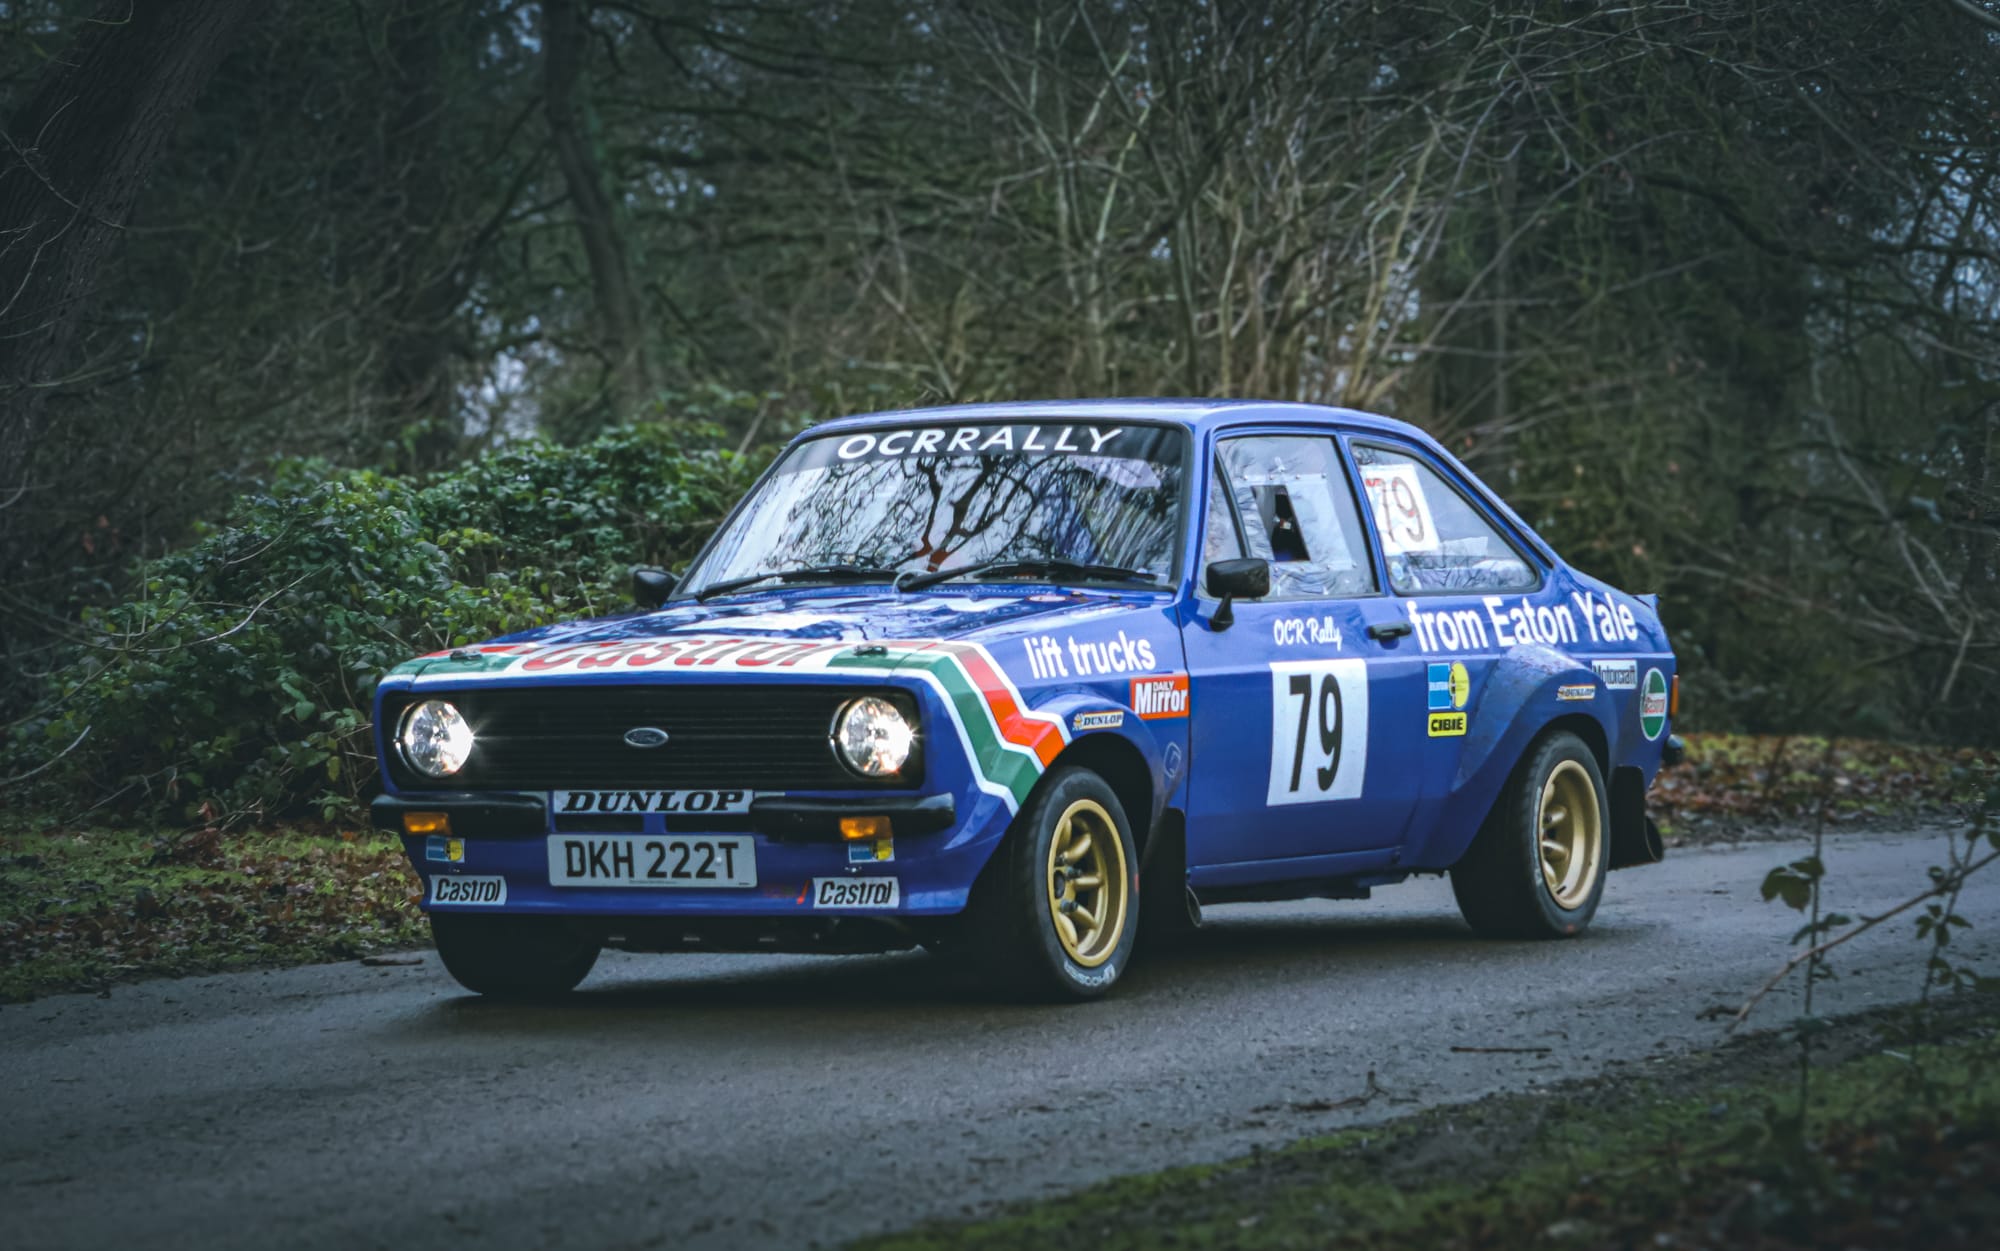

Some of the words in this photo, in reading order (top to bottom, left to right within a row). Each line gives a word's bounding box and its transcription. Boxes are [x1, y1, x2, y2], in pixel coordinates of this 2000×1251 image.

[1364, 476, 1425, 542] 79
[1273, 618, 1308, 647] OCR
[1306, 615, 1343, 652] Rally
[1406, 600, 1489, 653] from
[1482, 597, 1578, 647] Eaton
[1571, 591, 1639, 643] Yale
[521, 638, 855, 671] Castrol
[1023, 635, 1069, 680] lift
[1067, 630, 1156, 676] trucks
[1134, 682, 1188, 714] Mirror
[1152, 680, 1174, 691] DAILY
[1082, 714, 1122, 726] DUNLOP
[1289, 673, 1343, 792] 79
[562, 791, 744, 812] DUNLOP
[564, 841, 634, 878] DKH
[645, 841, 739, 879] 222T
[436, 878, 501, 902] Castrol
[818, 880, 893, 905] Castrol
